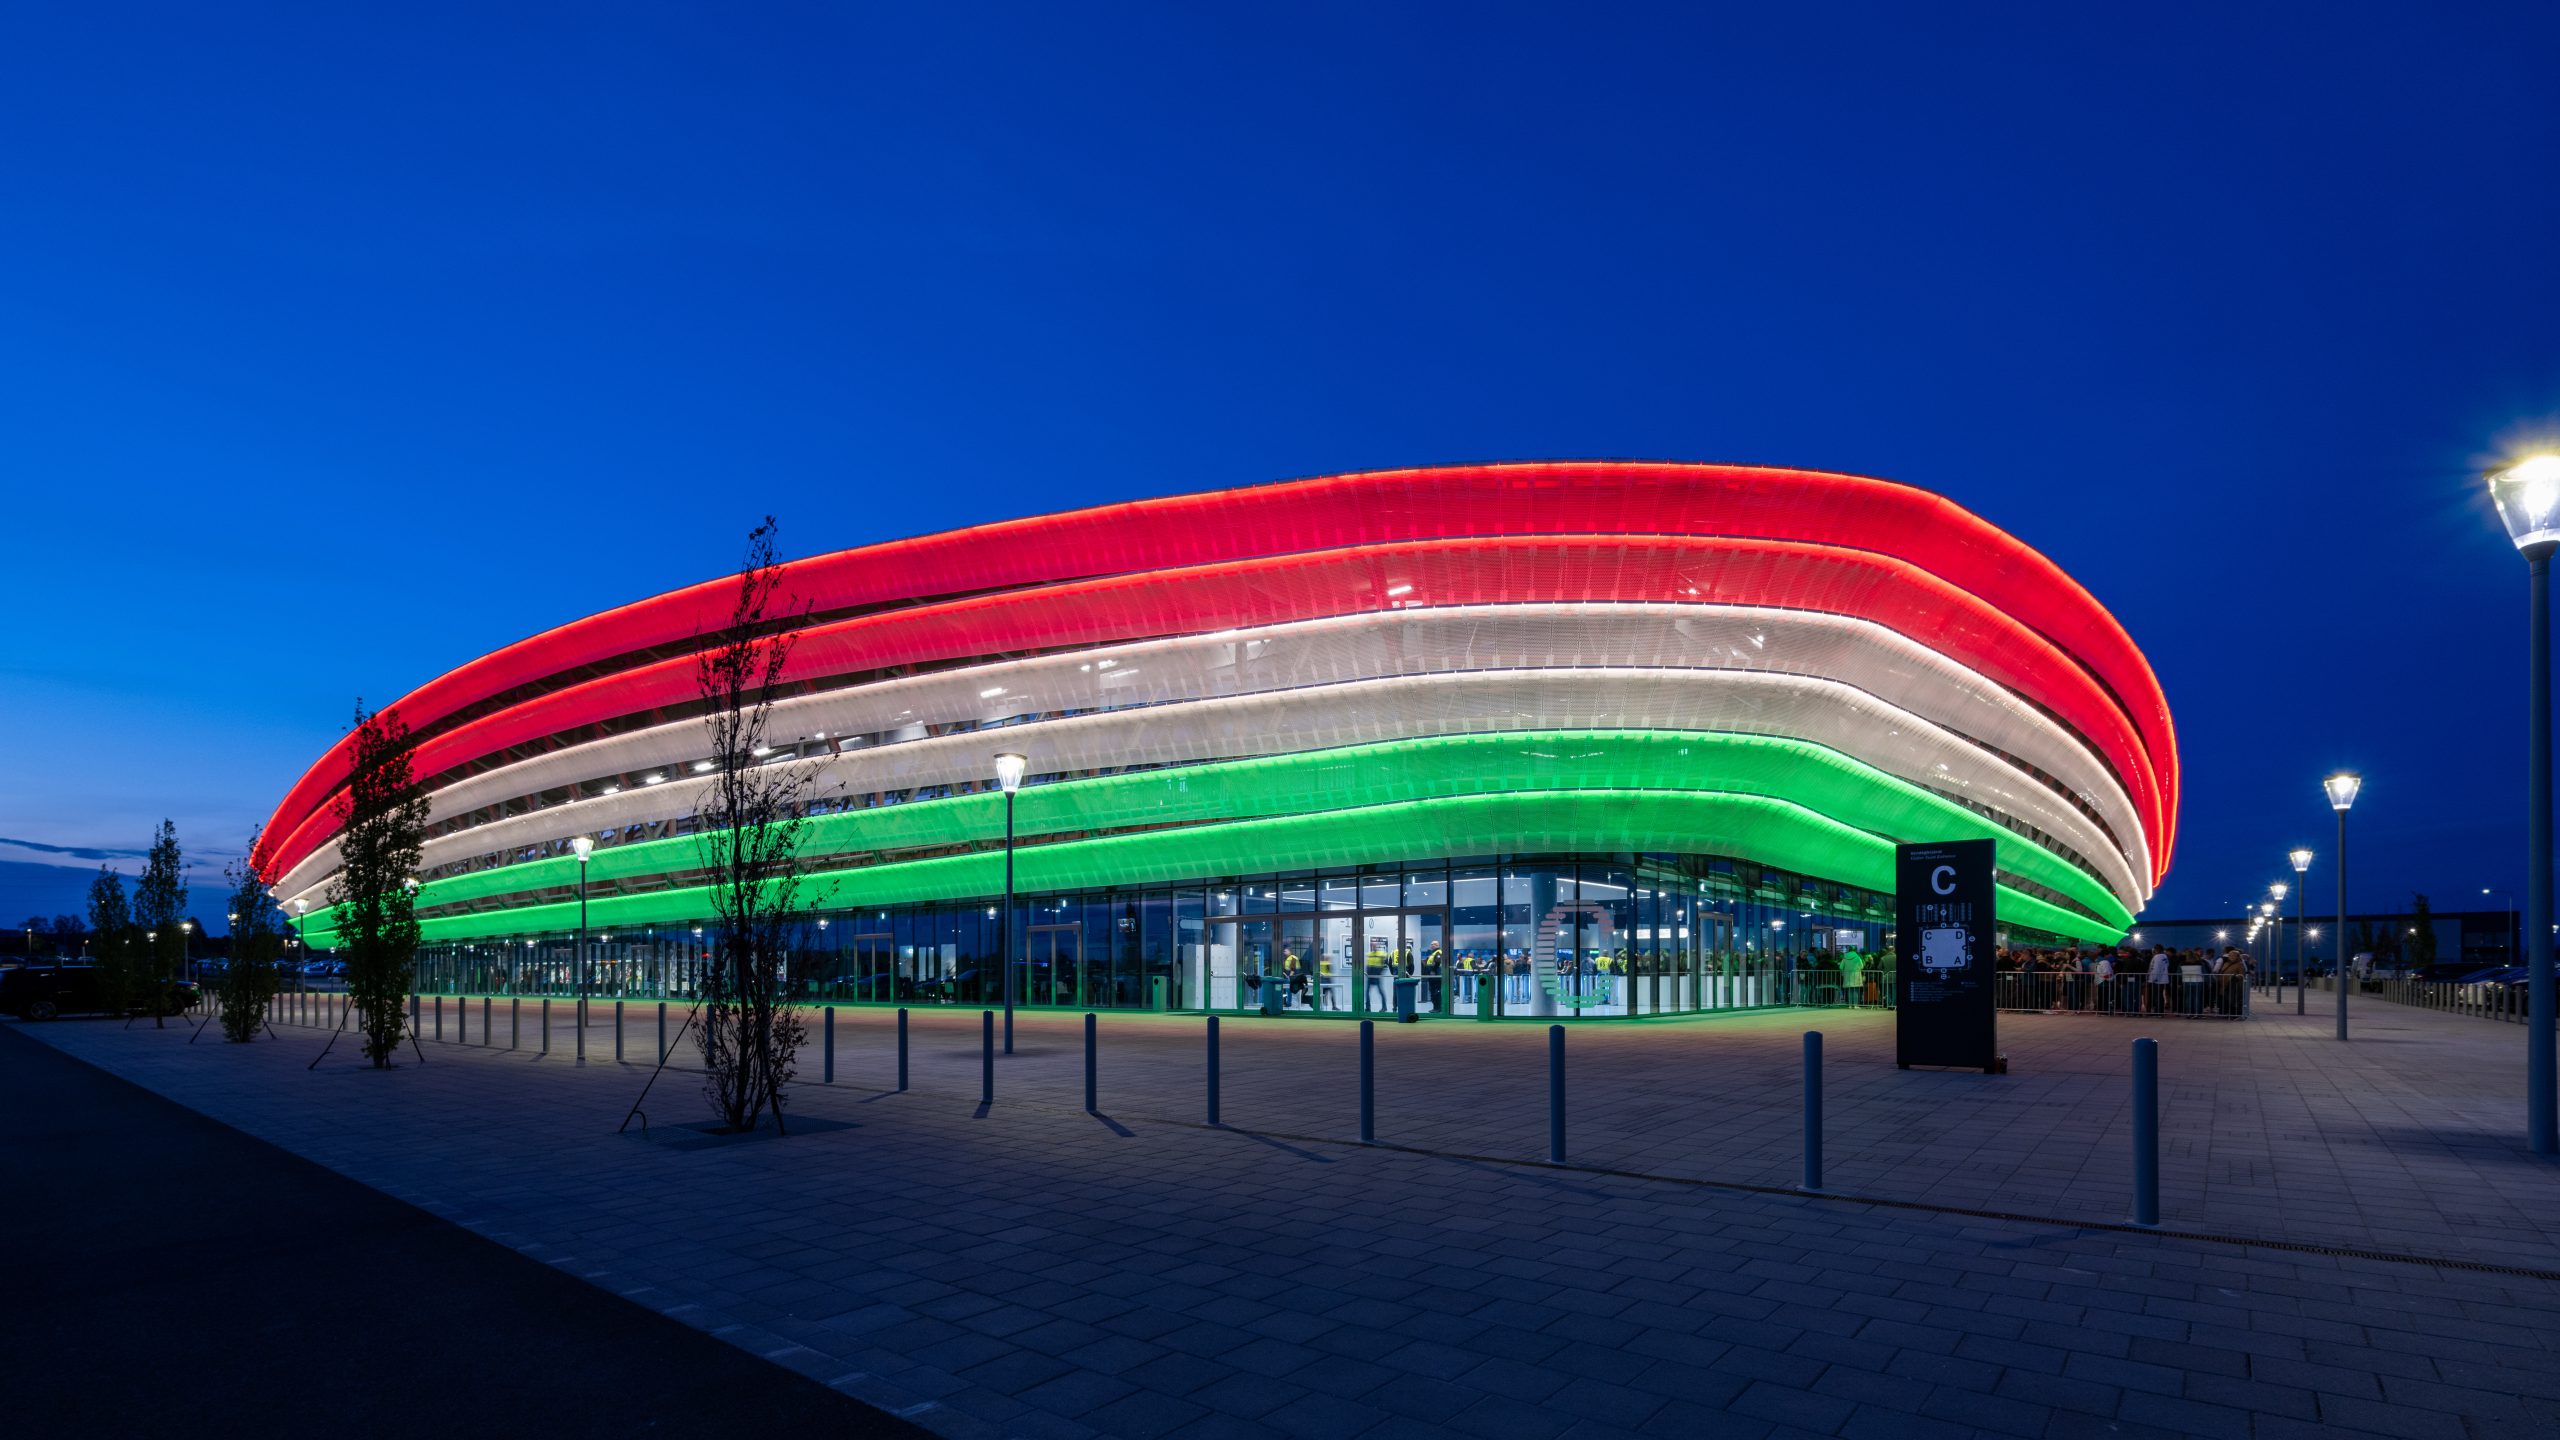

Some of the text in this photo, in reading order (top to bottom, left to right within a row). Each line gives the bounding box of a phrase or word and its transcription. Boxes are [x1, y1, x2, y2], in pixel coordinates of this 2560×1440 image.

[1931, 865, 1957, 895] C
[1924, 931, 1932, 940] C
[1955, 931, 1963, 940] D
[1925, 955, 1933, 964] B
[1954, 956, 1962, 965] A
